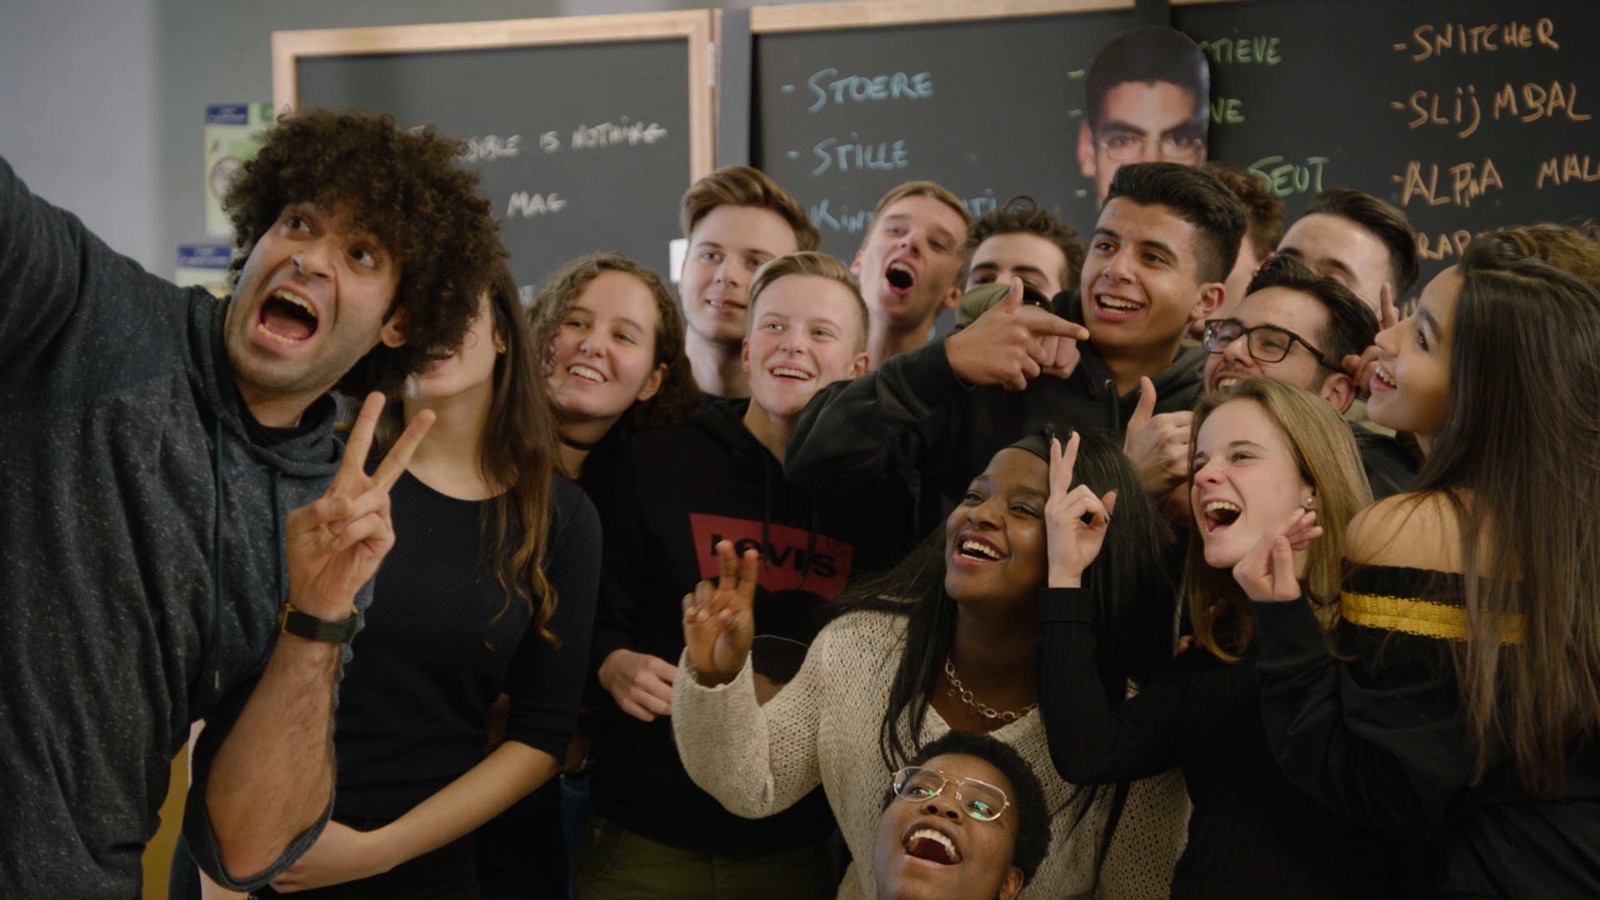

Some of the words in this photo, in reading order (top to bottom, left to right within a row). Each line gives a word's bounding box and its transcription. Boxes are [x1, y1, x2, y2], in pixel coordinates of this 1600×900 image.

[1199, 36, 1282, 65] TIEVE
[539, 130, 561, 154] IS
[1536, 153, 1600, 190] MAL
